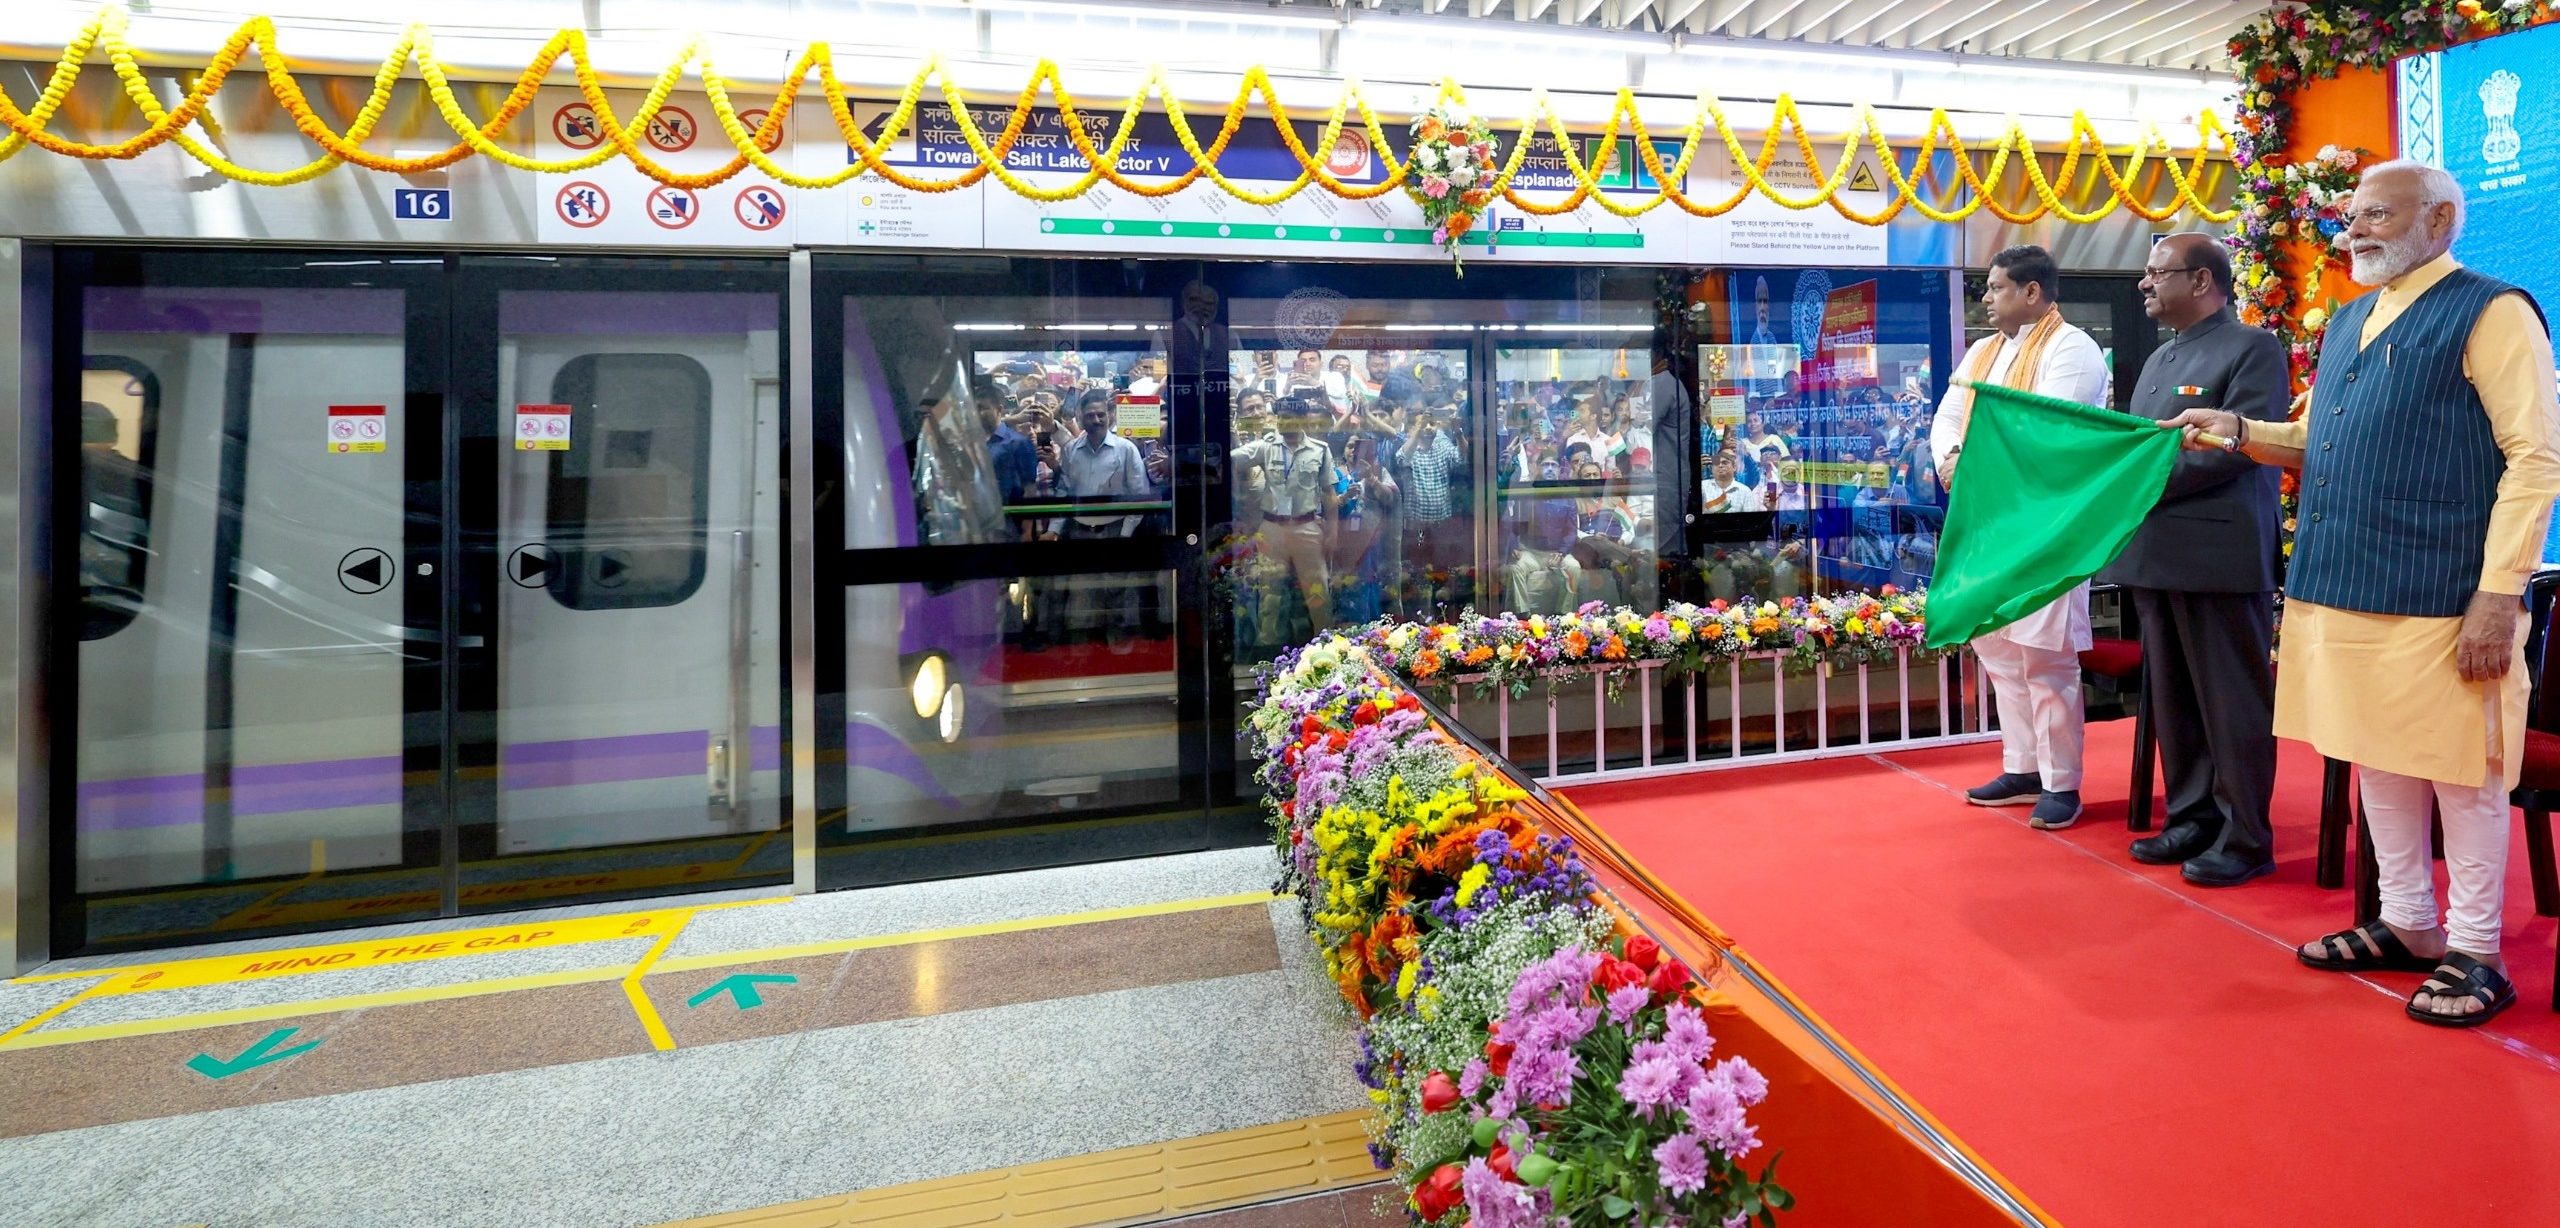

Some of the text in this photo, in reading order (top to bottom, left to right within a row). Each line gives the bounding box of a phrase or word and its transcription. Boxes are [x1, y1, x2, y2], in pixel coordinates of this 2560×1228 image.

[1032, 113, 1044, 128] V
[922, 147, 1170, 172] Towar Salt Lake ector V
[1731, 180, 1743, 188] You
[404, 193, 440, 216] 16
[238, 930, 555, 975] MIND THE GAP
